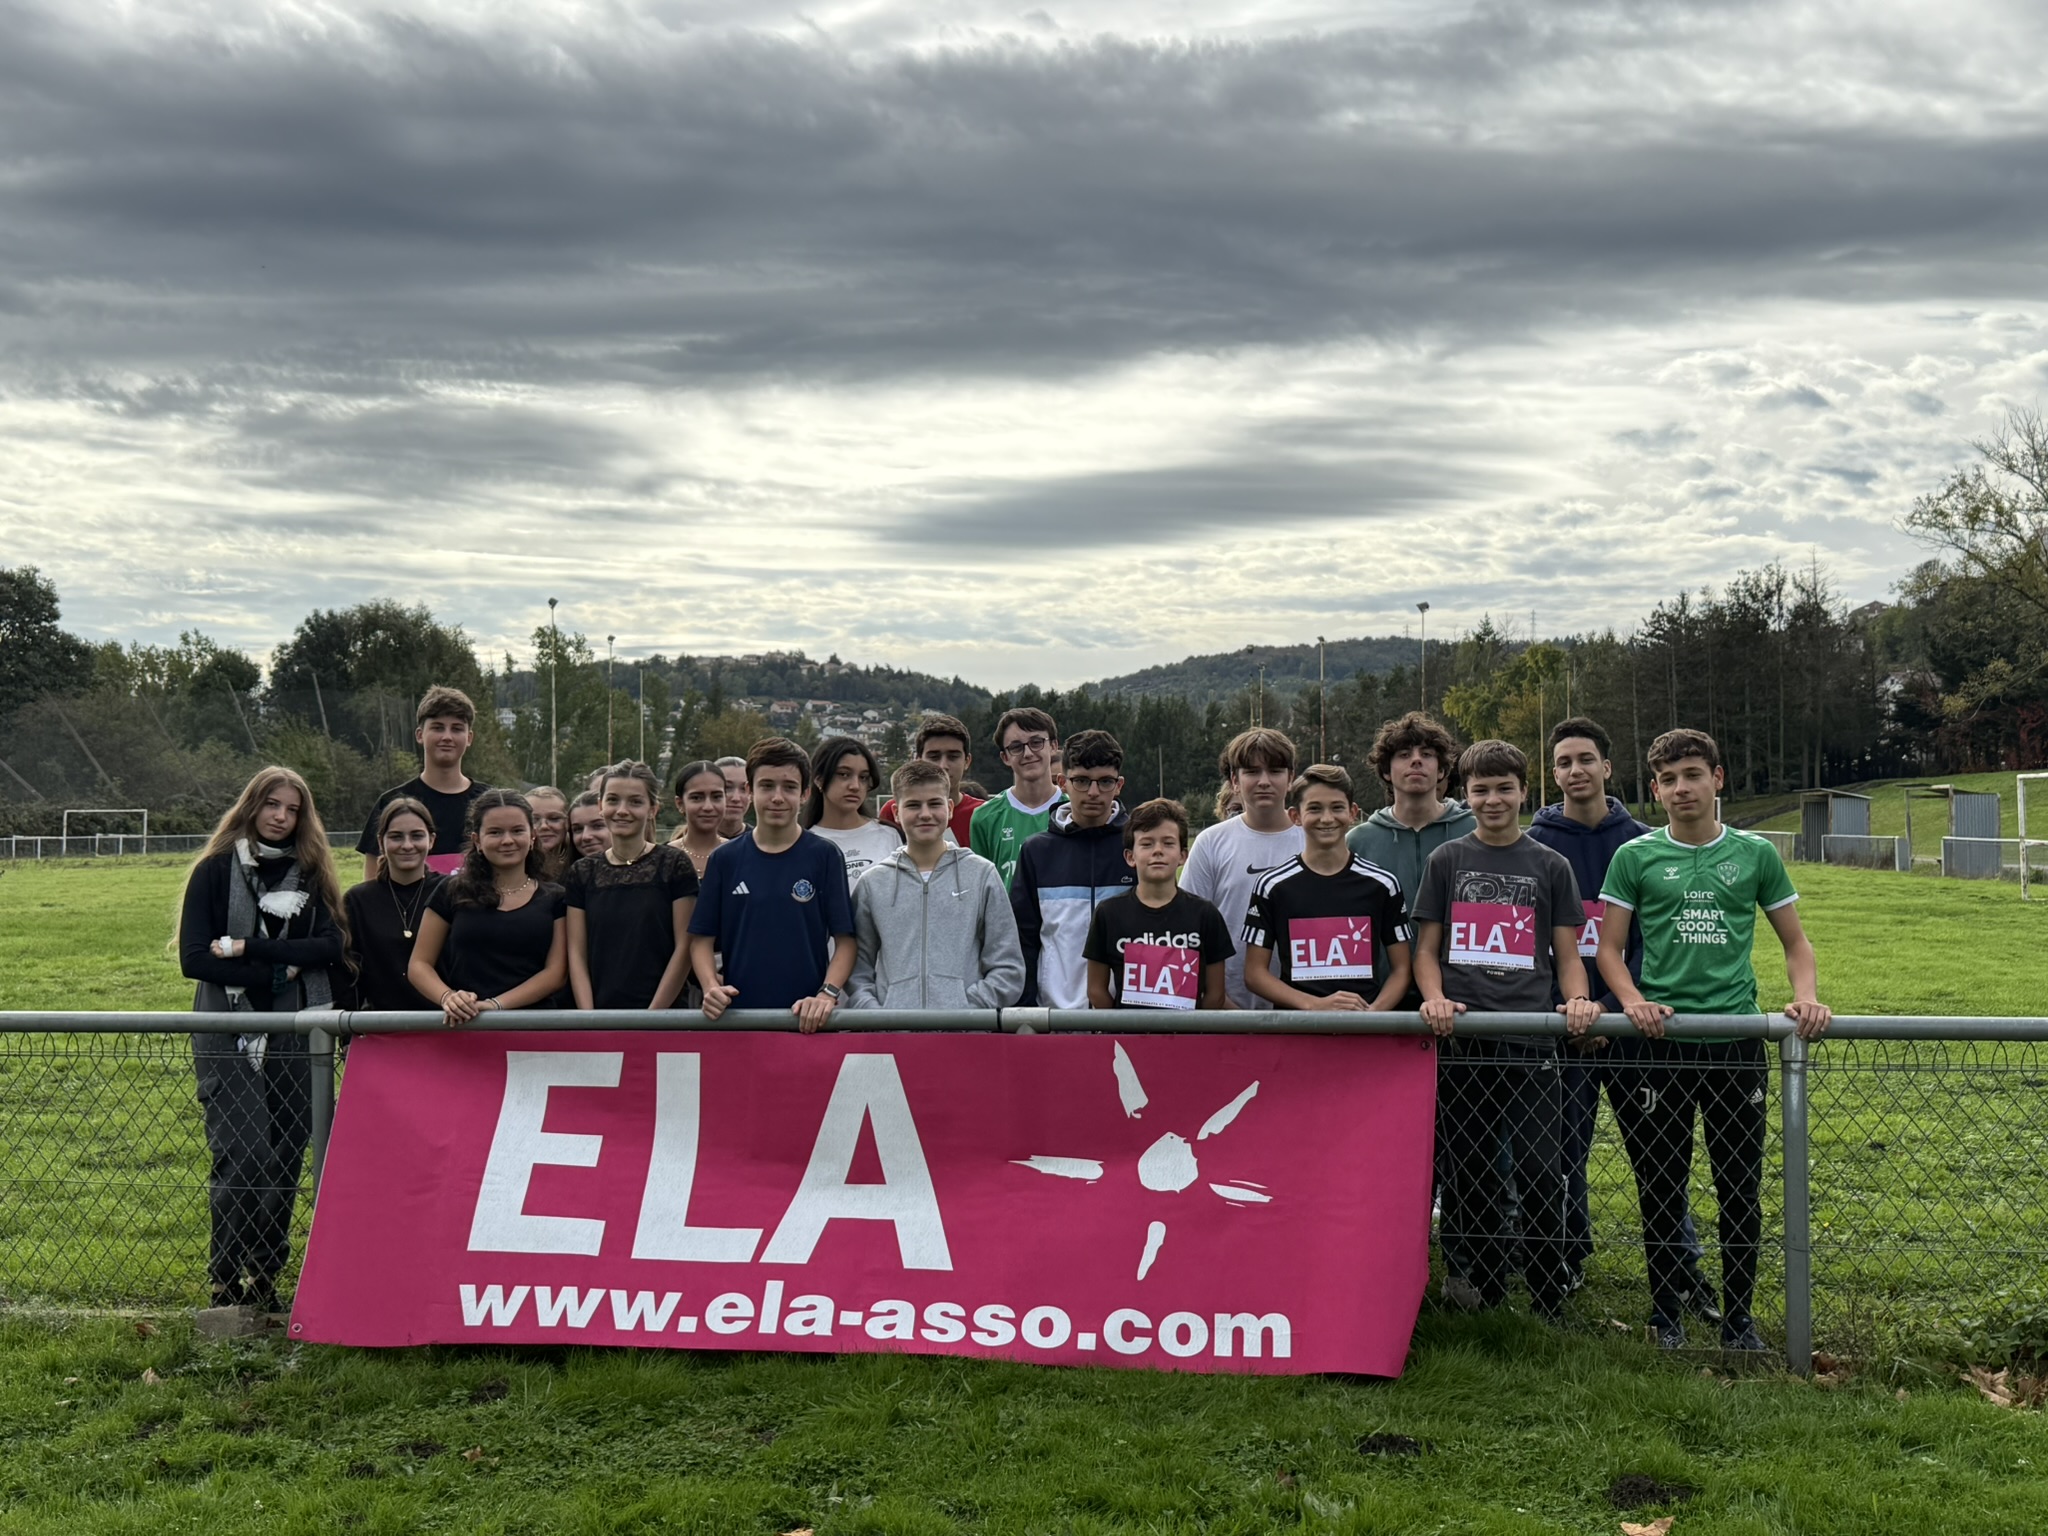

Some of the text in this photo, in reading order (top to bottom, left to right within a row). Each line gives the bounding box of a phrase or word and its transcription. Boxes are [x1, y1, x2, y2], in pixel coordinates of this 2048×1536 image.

[1116, 931, 1201, 953] adidas
[1290, 937, 1348, 967] ELA
[1450, 922, 1507, 953] ELA
[1123, 962, 1175, 995] ELA
[467, 1050, 954, 1272] ELA
[458, 1280, 1292, 1358] www.ela-asso.com
